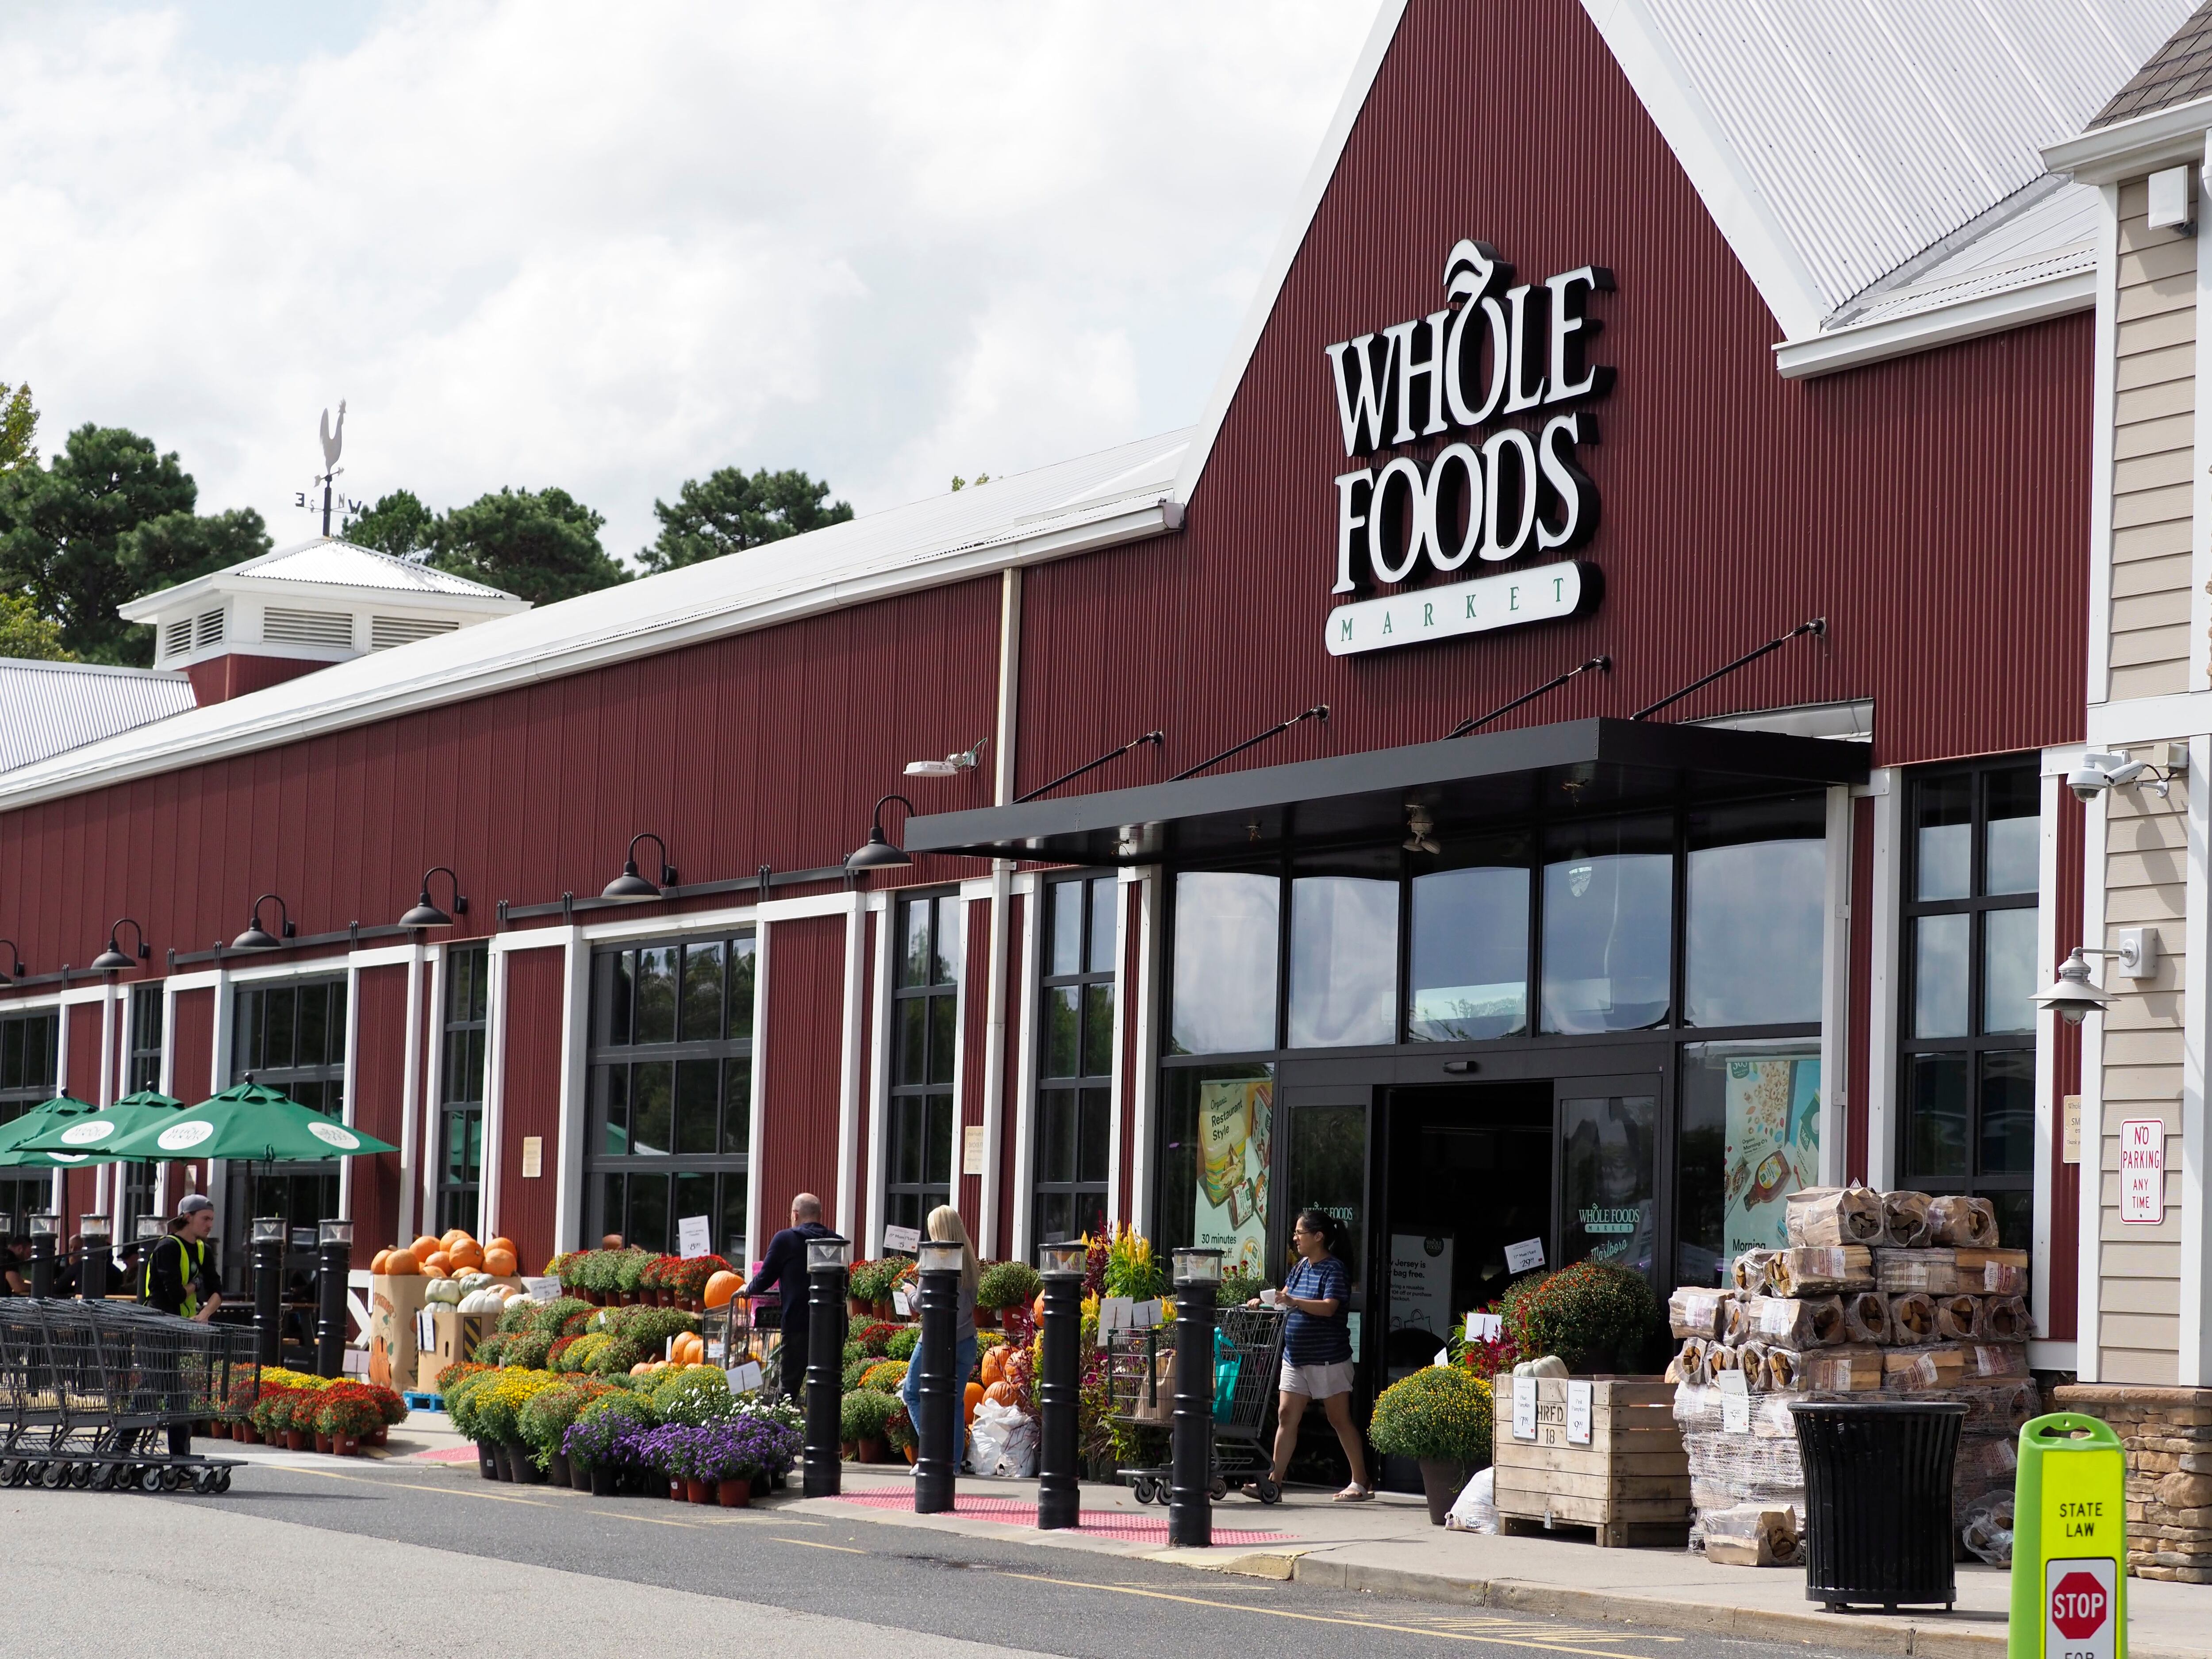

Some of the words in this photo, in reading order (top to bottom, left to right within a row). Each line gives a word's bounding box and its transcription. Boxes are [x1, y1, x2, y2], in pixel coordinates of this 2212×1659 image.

[1326, 238, 1595, 457] WHOLE
[1332, 412, 1579, 594] FOODS
[1340, 578, 1564, 642] MARKET
[1210, 1096, 1228, 1110] Organic
[1211, 1098, 1243, 1127] Restaurant
[1213, 1125, 1229, 1141] Style
[2135, 1127, 2149, 1145] NO
[1743, 1142, 1761, 1151] Morning
[2123, 1150, 2159, 1168] PARKING
[2133, 1179, 2148, 1190] ANY
[2132, 1196, 2150, 1208] TIME
[1329, 1207, 1353, 1221] FOODS
[1578, 1202, 1610, 1223] WHOLE
[1611, 1209, 1640, 1223] FOODS
[1201, 1234, 1210, 1244] 30
[1211, 1233, 1237, 1244] minutes
[1590, 1239, 1628, 1262] Marlboro
[1395, 1259, 1418, 1268] Jersey
[1394, 1269, 1406, 1279] bag
[1546, 1428, 1555, 1444] 18
[2059, 1502, 2103, 1517] STATE
[2066, 1522, 2094, 1537] LAW
[2054, 1593, 2104, 1619] STOP
